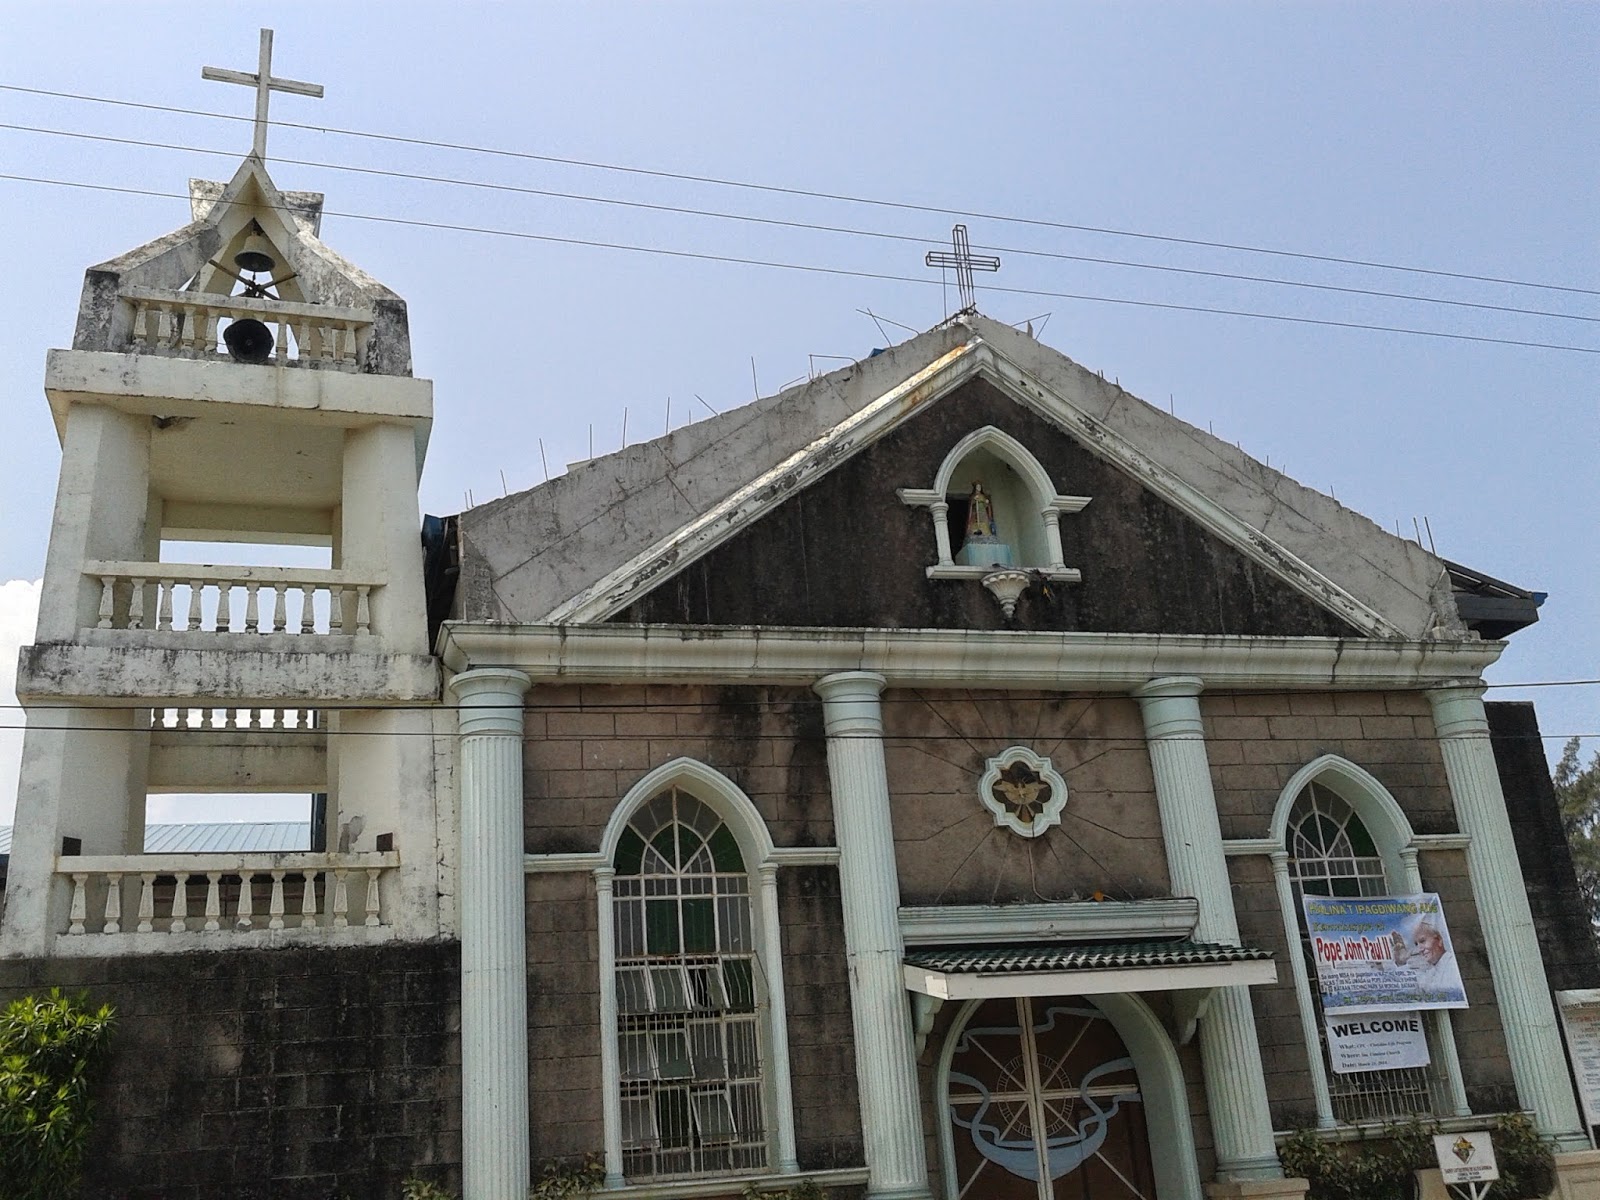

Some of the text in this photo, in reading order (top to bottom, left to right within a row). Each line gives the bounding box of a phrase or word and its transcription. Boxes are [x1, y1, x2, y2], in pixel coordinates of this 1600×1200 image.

[1354, 903, 1417, 915] IPAGDIWANG
[1316, 937, 1342, 969] Pope
[1342, 936, 1365, 960] John
[1362, 936, 1384, 960] Paul
[1332, 1020, 1419, 1038] WELCOME
